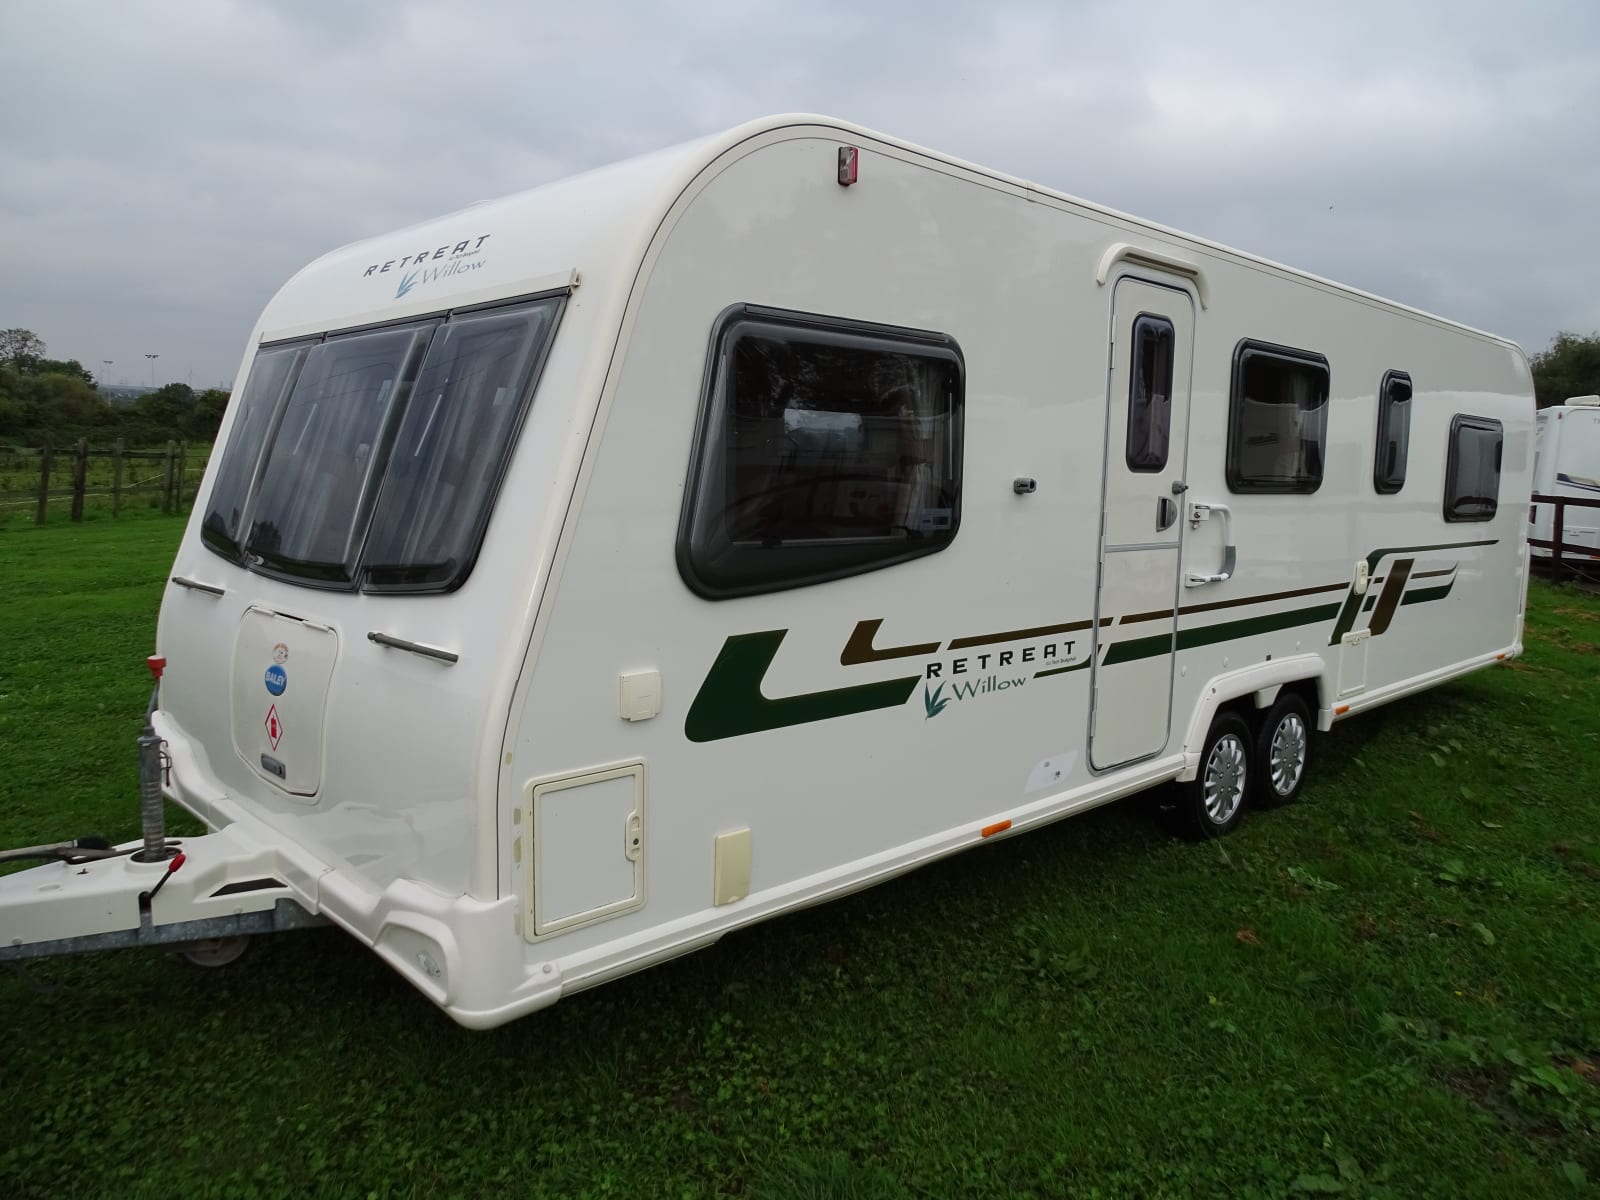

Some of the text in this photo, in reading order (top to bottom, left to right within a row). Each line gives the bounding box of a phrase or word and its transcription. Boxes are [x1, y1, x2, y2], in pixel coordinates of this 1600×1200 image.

[363, 234, 490, 277] RETREAT
[422, 259, 486, 284] Willow
[926, 640, 1076, 679] RETREAT
[265, 671, 286, 687] BAILEY
[951, 675, 1026, 701] Willow
